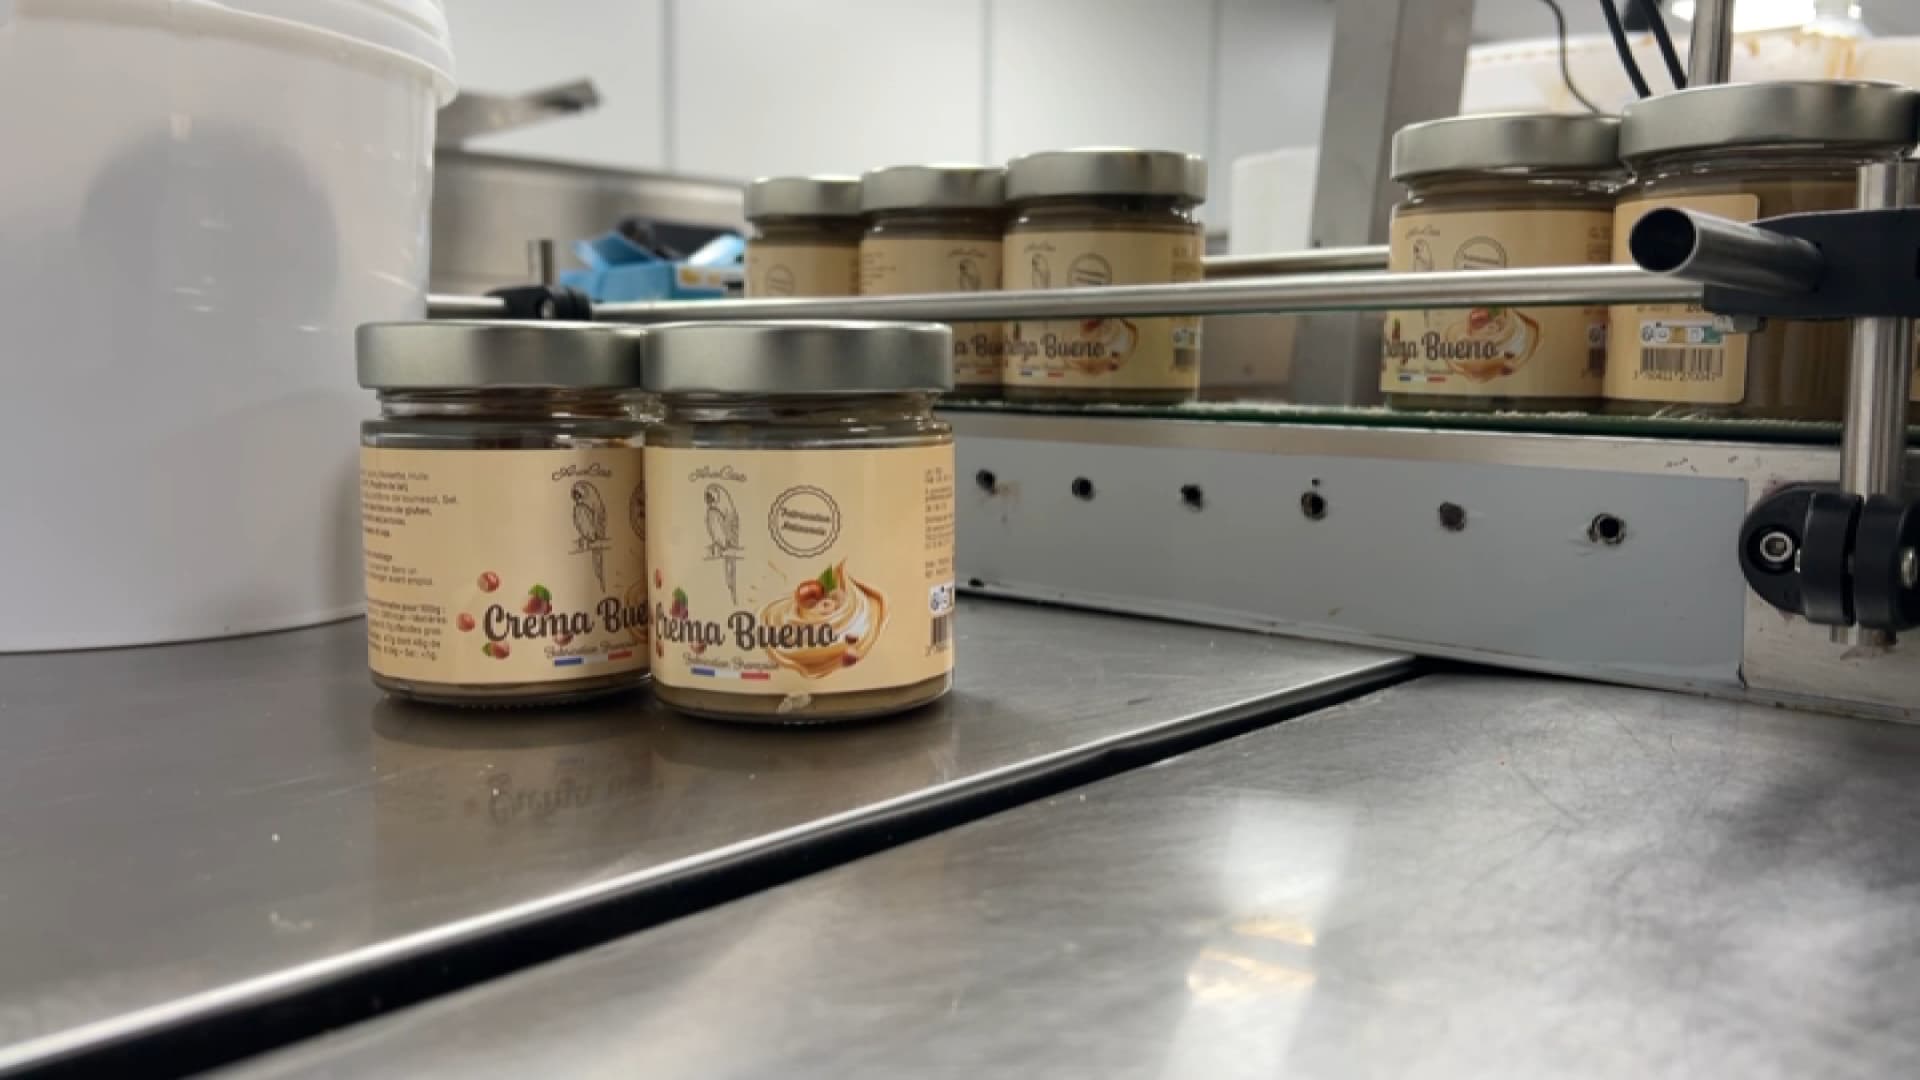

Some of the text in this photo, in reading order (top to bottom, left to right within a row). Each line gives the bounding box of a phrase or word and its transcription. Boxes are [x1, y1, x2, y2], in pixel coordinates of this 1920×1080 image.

[1421, 331, 1499, 361] Bueno
[484, 604, 595, 642] Crema
[596, 596, 650, 633] Bue
[727, 610, 840, 651] Bueno
